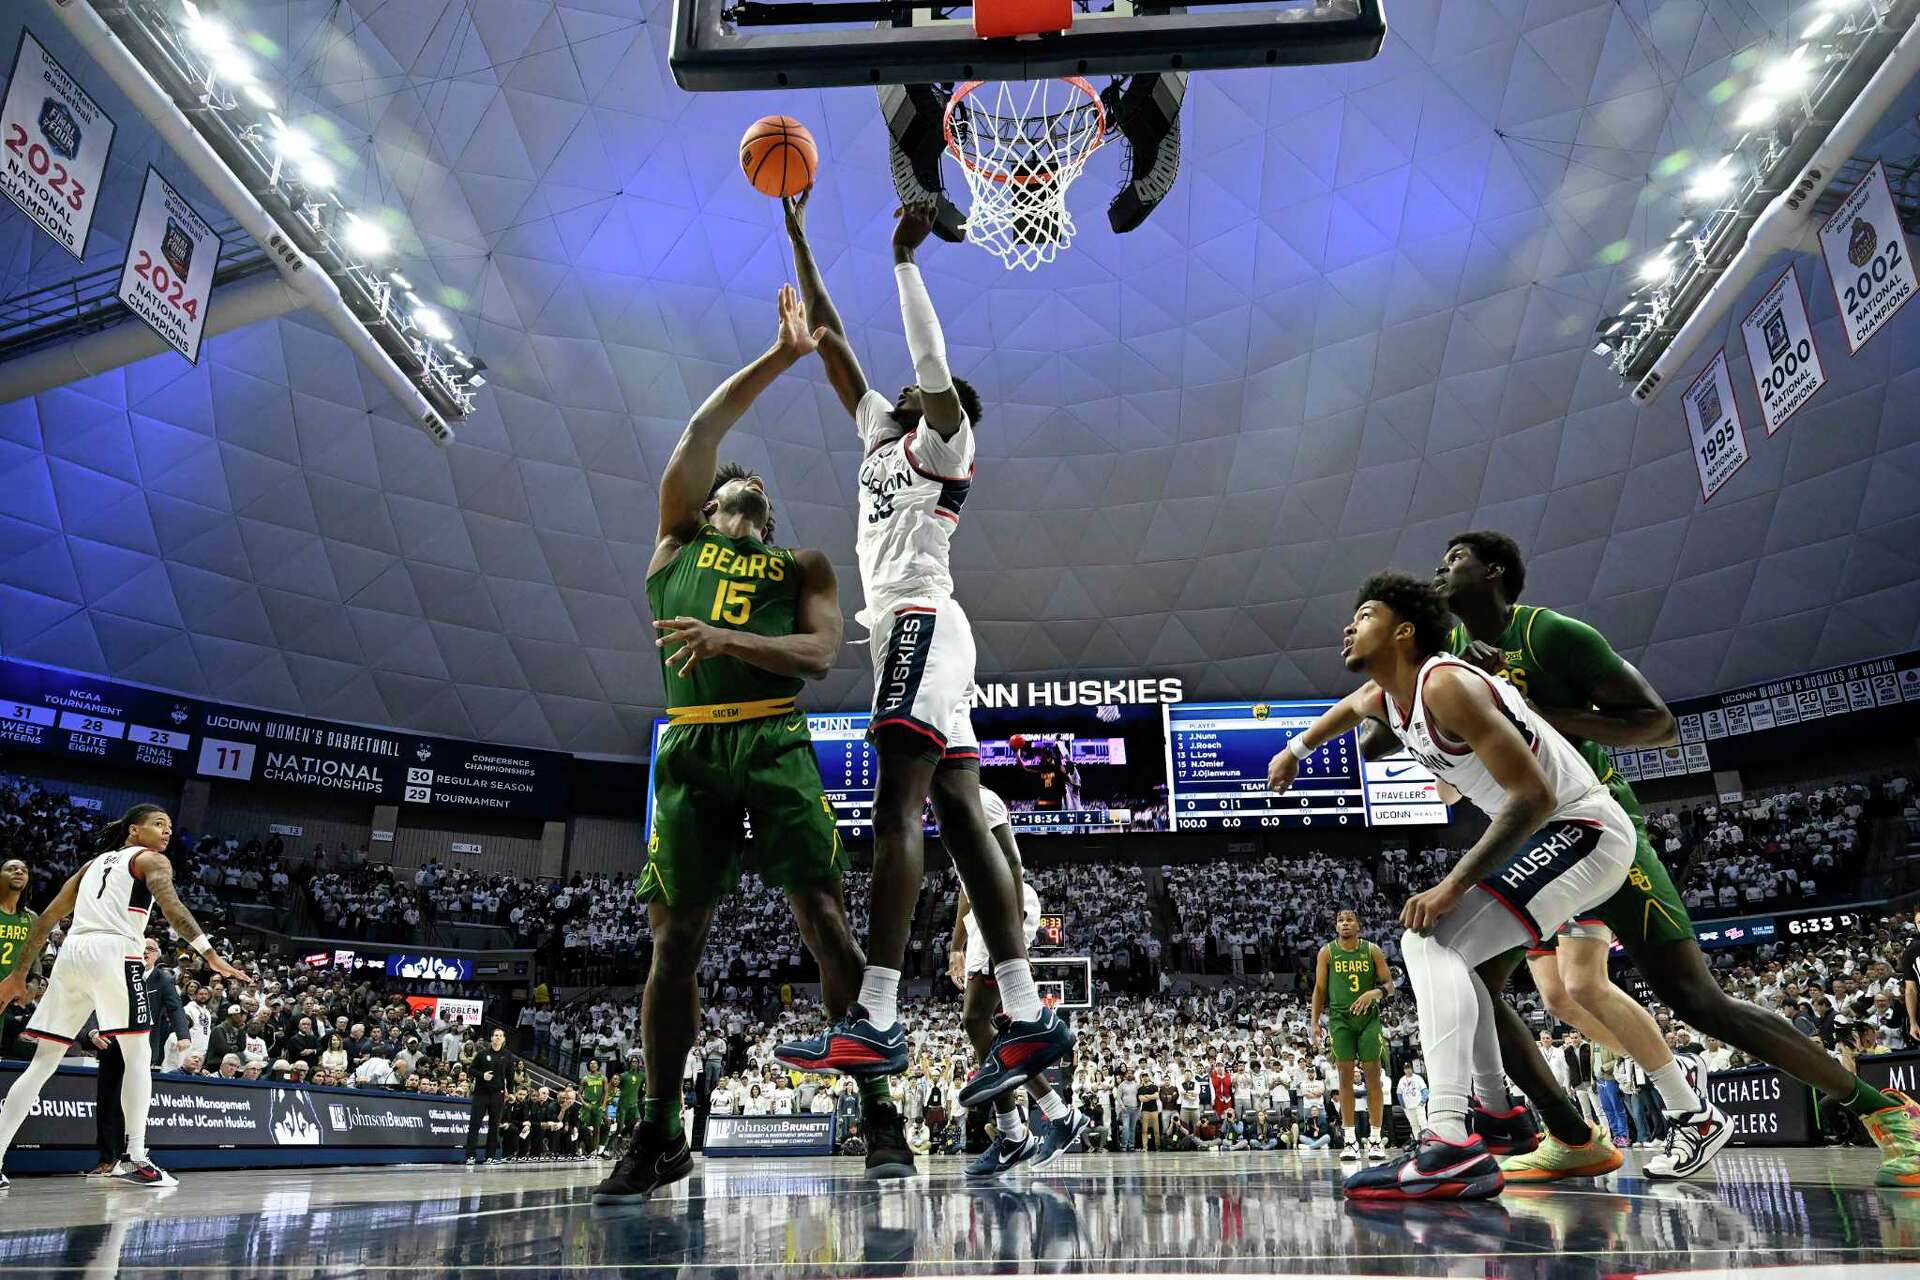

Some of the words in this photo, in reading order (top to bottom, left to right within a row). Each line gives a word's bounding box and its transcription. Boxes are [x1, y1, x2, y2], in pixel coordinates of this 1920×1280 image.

[41, 51, 72, 90] UConn
[74, 87, 100, 119] Men's
[43, 70, 92, 125] Basketball
[5, 123, 86, 211] 2023
[7, 158, 73, 226] NATIONAL
[162, 183, 187, 215] UConn
[1824, 206, 1846, 234] UConn
[1846, 170, 1877, 207] Women's
[0, 171, 75, 246] CHAMPIONS
[1836, 191, 1870, 235] Basketball
[164, 199, 203, 242] Basketball
[134, 249, 198, 323] 2024
[1844, 240, 1903, 315] 2002
[136, 280, 188, 336] NATIONAL
[1855, 274, 1902, 325] NATIONAL
[128, 292, 190, 353] CHAMPIONS
[1856, 282, 1910, 342] CHAMPIONS
[1761, 338, 1811, 403] 2000
[1771, 368, 1811, 411] NATIONAL
[1772, 377, 1818, 426] CHAMPIONS
[1700, 418, 1735, 466] 1995
[1707, 444, 1738, 478] NATIONAL
[1707, 452, 1743, 493] CHAMPIONS
[696, 543, 785, 582] BEARS
[711, 579, 757, 625] 15
[885, 618, 921, 712] HUSKIES
[1028, 677, 1183, 707] HUSKIES
[1721, 690, 1757, 704] UCONN
[1759, 679, 1802, 698] WOMEN'S
[1803, 669, 1845, 689] HUSKIES
[1847, 666, 1858, 680] OF
[1861, 659, 1895, 676] HONOR
[1875, 676, 1896, 688] 23
[44, 694, 123, 717] TOURNAMENT
[69, 689, 101, 702] NCAA
[13, 705, 32, 719] 31
[1681, 716, 1699, 727] 42
[1708, 712, 1718, 722] 3
[1727, 707, 1746, 719] 52
[0, 720, 44, 736] WEET
[81, 718, 104, 731] 28
[206, 714, 261, 733] UCONN
[265, 721, 323, 745] WOMEN'S
[327, 731, 400, 757] BASKETBALL
[68, 742, 106, 756] EIGHTS
[70, 733, 108, 748] ELITE
[149, 731, 170, 744] 23
[135, 753, 173, 768] FOURS
[137, 745, 174, 759] FINAL
[216, 747, 241, 771] 11
[472, 754, 530, 767] CONFERENCE
[266, 751, 384, 782] NATIONAL
[464, 762, 536, 777] CHAMPIONSHIPS
[1191, 760, 1224, 768] N.Omier
[263, 768, 383, 794] CHAMPIONSHIPS
[411, 770, 430, 782] 30
[436, 774, 488, 788] REGULAR
[490, 780, 534, 793] SEASON
[1241, 783, 1265, 791] TEAM
[408, 789, 427, 800] 29
[435, 793, 511, 809] TOURNAMENT
[1187, 800, 1196, 809] 0
[1300, 798, 1309, 807] 0
[1337, 796, 1345, 806] 0
[1376, 790, 1426, 800] TRAVELERS
[852, 809, 861, 818] 0
[1028, 814, 1060, 824] 18:34
[1084, 814, 1092, 823] 2
[1178, 819, 1207, 829] 100.0
[1222, 818, 1241, 827] 0.0
[1261, 817, 1280, 826] 0.0
[1303, 816, 1311, 826] 0
[1339, 815, 1348, 825] 0
[1375, 811, 1411, 819] UCONN
[852, 827, 861, 836] 0
[96, 866, 112, 899] 1
[1049, 928, 1059, 943] 9
[1788, 916, 1835, 935] 6:33
[1, 942, 14, 965] 2
[1334, 960, 1369, 973] BEARS
[130, 964, 147, 1024] HUSKIES
[1348, 974, 1360, 992] 3
[440, 1005, 479, 1015] PROBLEM
[161, 1093, 195, 1109] Wealth
[195, 1096, 251, 1114] Management
[167, 1113, 179, 1127] of
[178, 1115, 194, 1128] the
[194, 1115, 224, 1129] UConn
[225, 1115, 256, 1129] Huskies
[731, 1119, 829, 1135] JohnsonBRUNETTI
